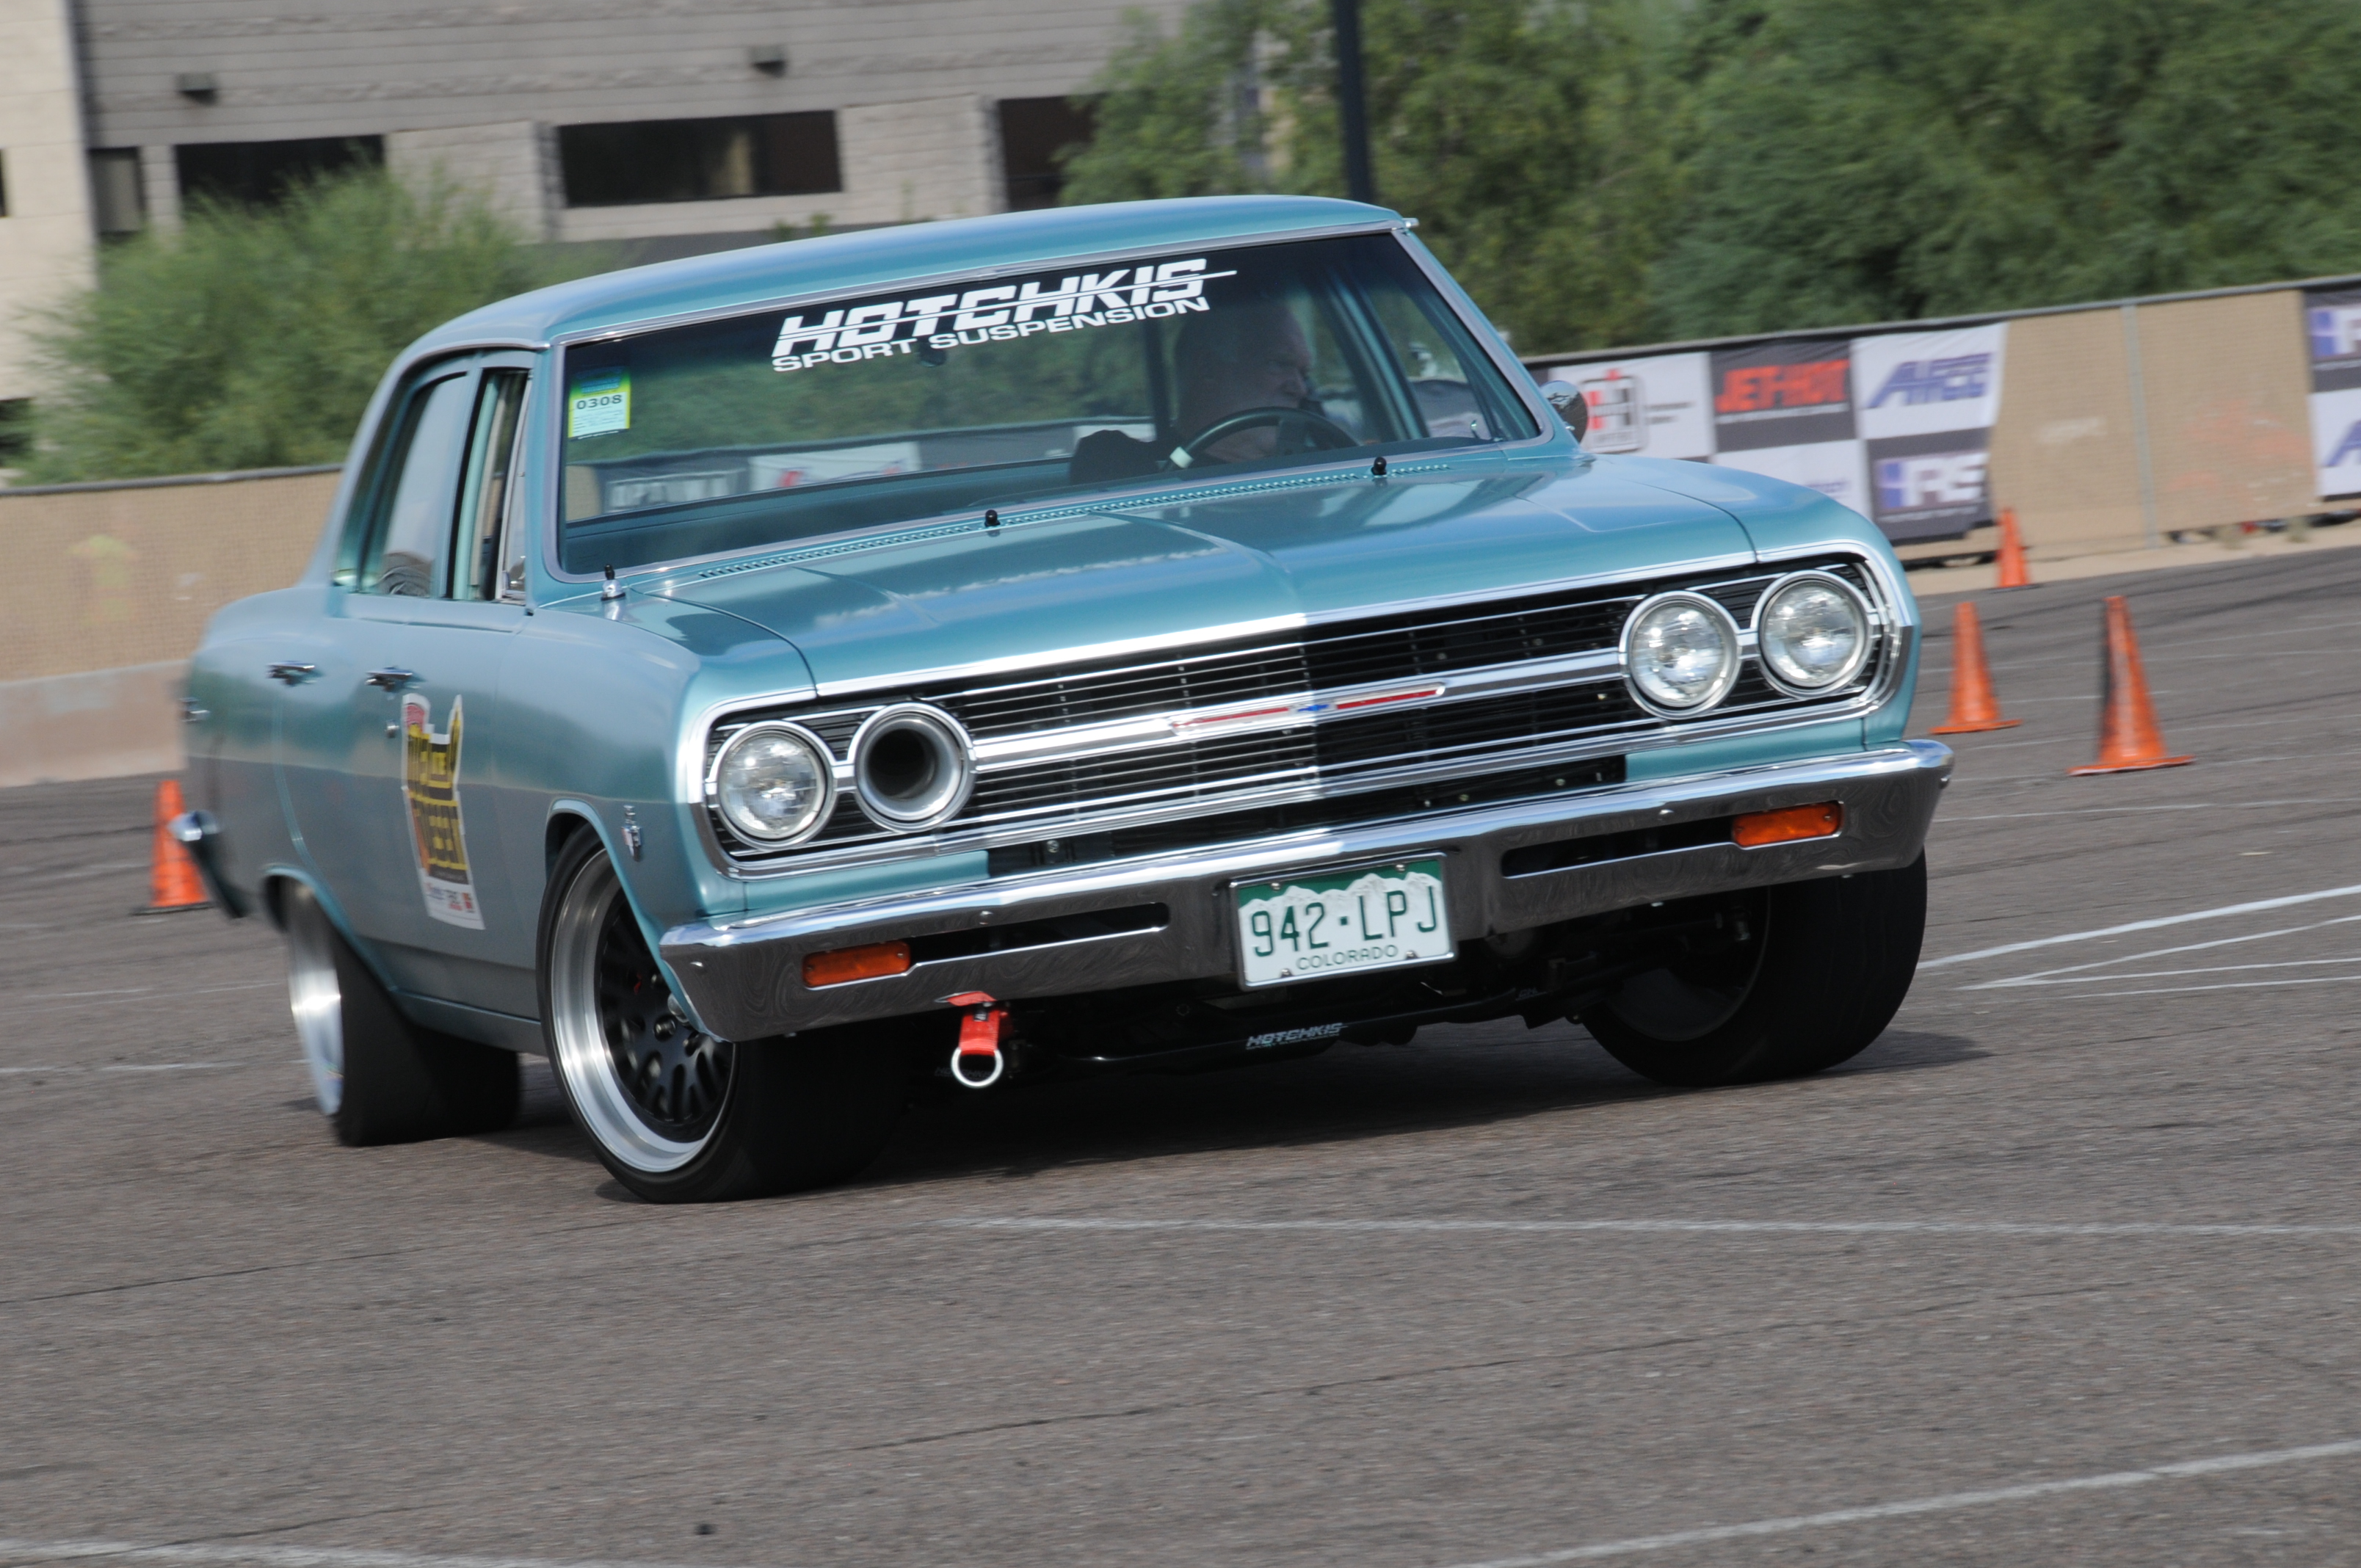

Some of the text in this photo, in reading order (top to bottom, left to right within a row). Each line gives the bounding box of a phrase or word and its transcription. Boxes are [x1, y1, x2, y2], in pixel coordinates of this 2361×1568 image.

[772, 258, 1208, 357] HOTCHKIS
[772, 297, 1210, 372] SPORT SUSPENSION
[576, 394, 623, 410] 0308
[1296, 945, 1399, 970] COLORADO
[1246, 1023, 1343, 1047] HOTCHKIS
